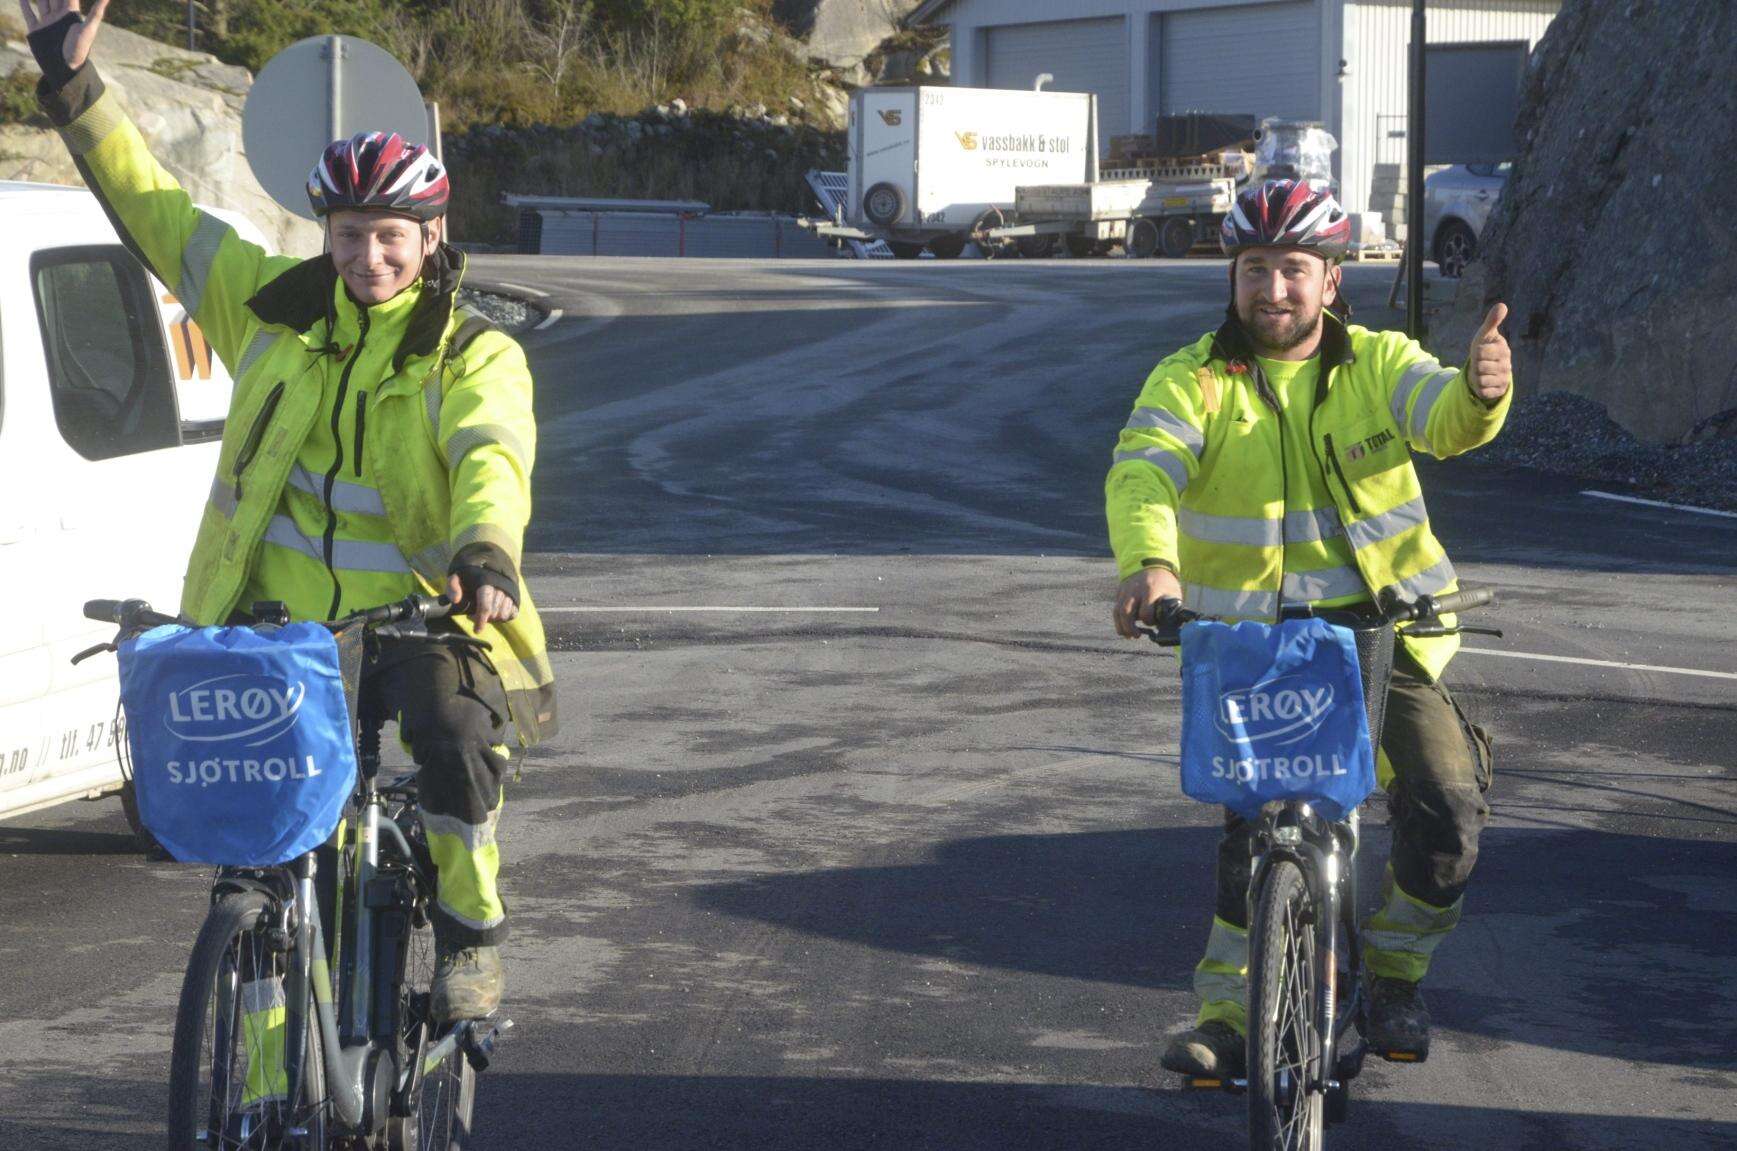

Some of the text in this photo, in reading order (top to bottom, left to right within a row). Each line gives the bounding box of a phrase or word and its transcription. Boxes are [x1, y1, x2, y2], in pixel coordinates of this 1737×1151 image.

[982, 134, 1035, 152] vassbakk
[1038, 134, 1046, 152] &
[1049, 136, 1070, 153] stol
[985, 158, 1049, 168] SPYLEVOGN
[1364, 428, 1396, 451] TOTAL
[169, 687, 295, 722] LERØY
[86, 721, 104, 752] 47
[166, 754, 323, 788] SJØTROLL
[1212, 754, 1347, 786] SJØTROLL
